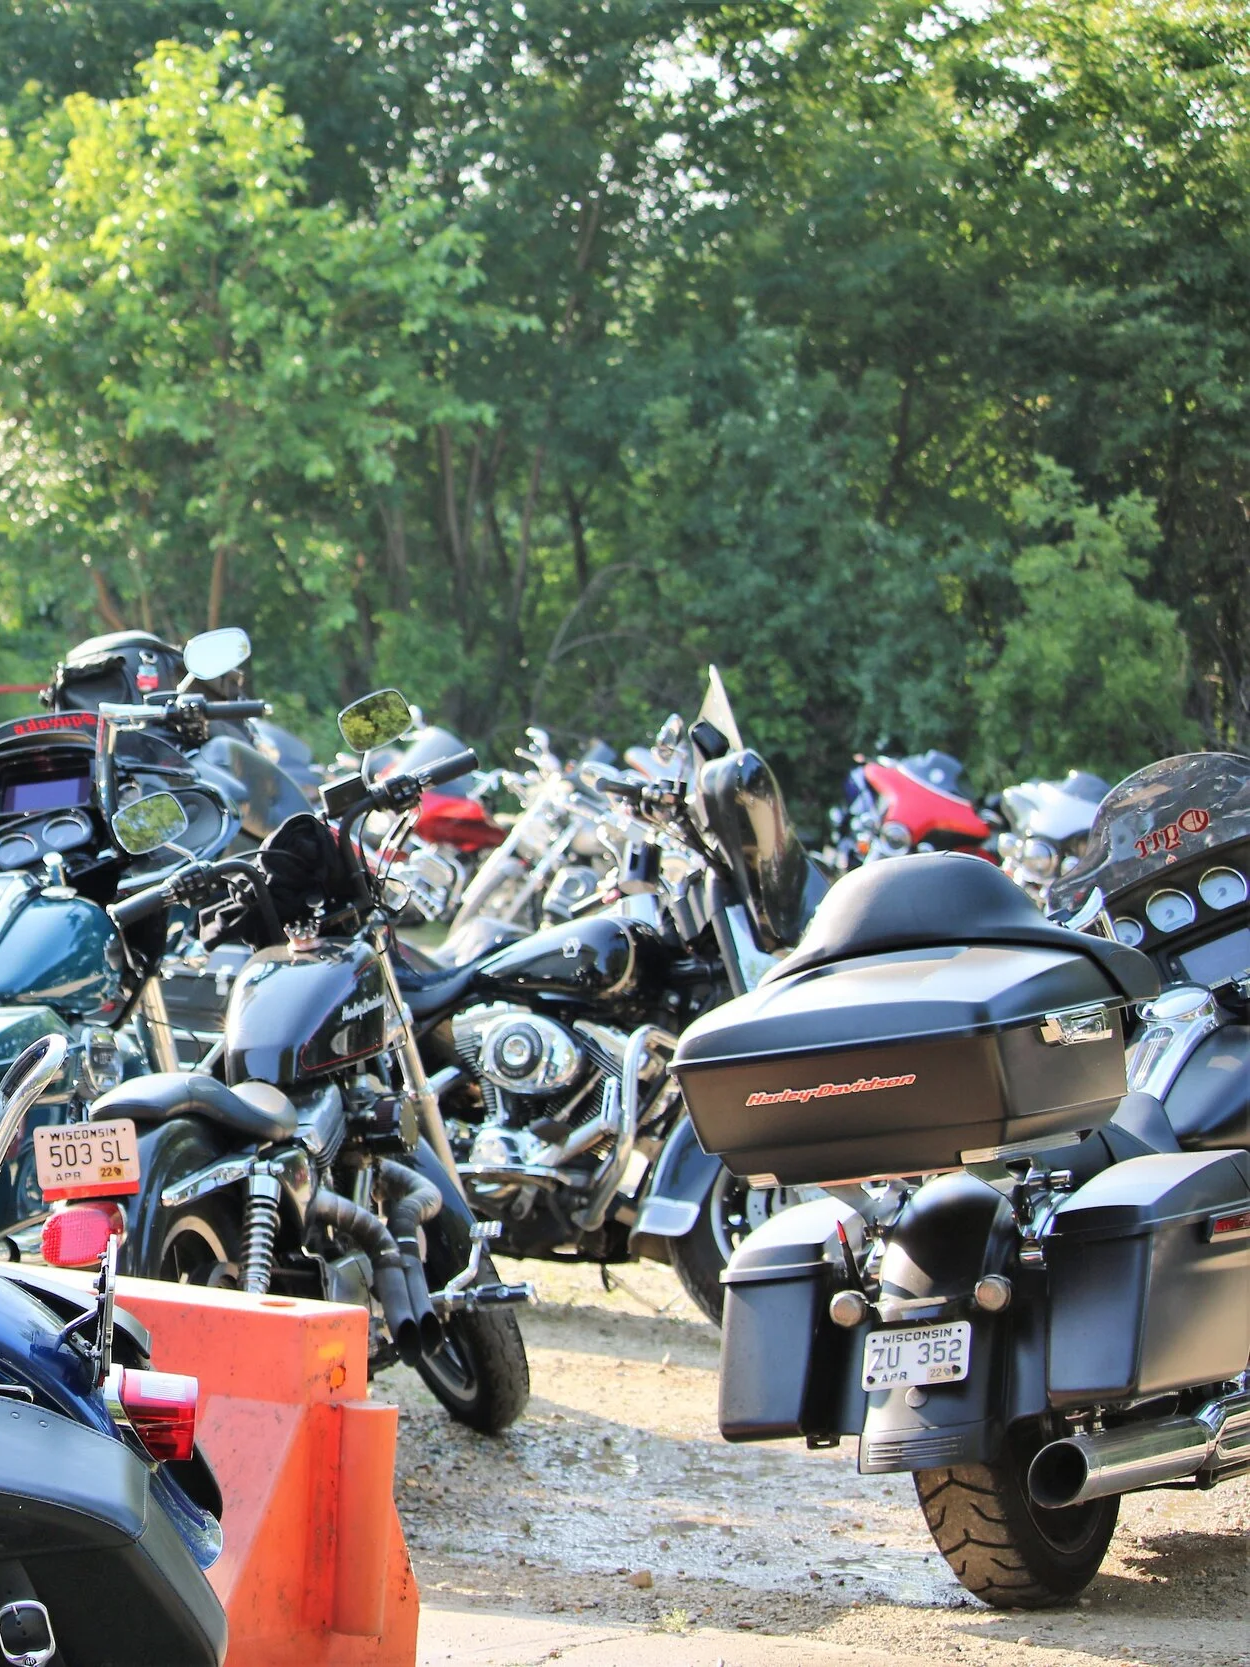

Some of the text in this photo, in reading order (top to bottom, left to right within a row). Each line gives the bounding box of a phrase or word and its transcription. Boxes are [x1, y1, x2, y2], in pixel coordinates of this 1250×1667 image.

[745, 1074, 917, 1106] Harley-Davidson
[49, 1128, 117, 1141] WISCONSIN
[49, 1140, 130, 1168] 503 SL
[56, 1167, 111, 1182] APR 22
[882, 1328, 953, 1344] WISCONSIN
[872, 1339, 962, 1371] ZU 352
[881, 1368, 942, 1383] APR 22
